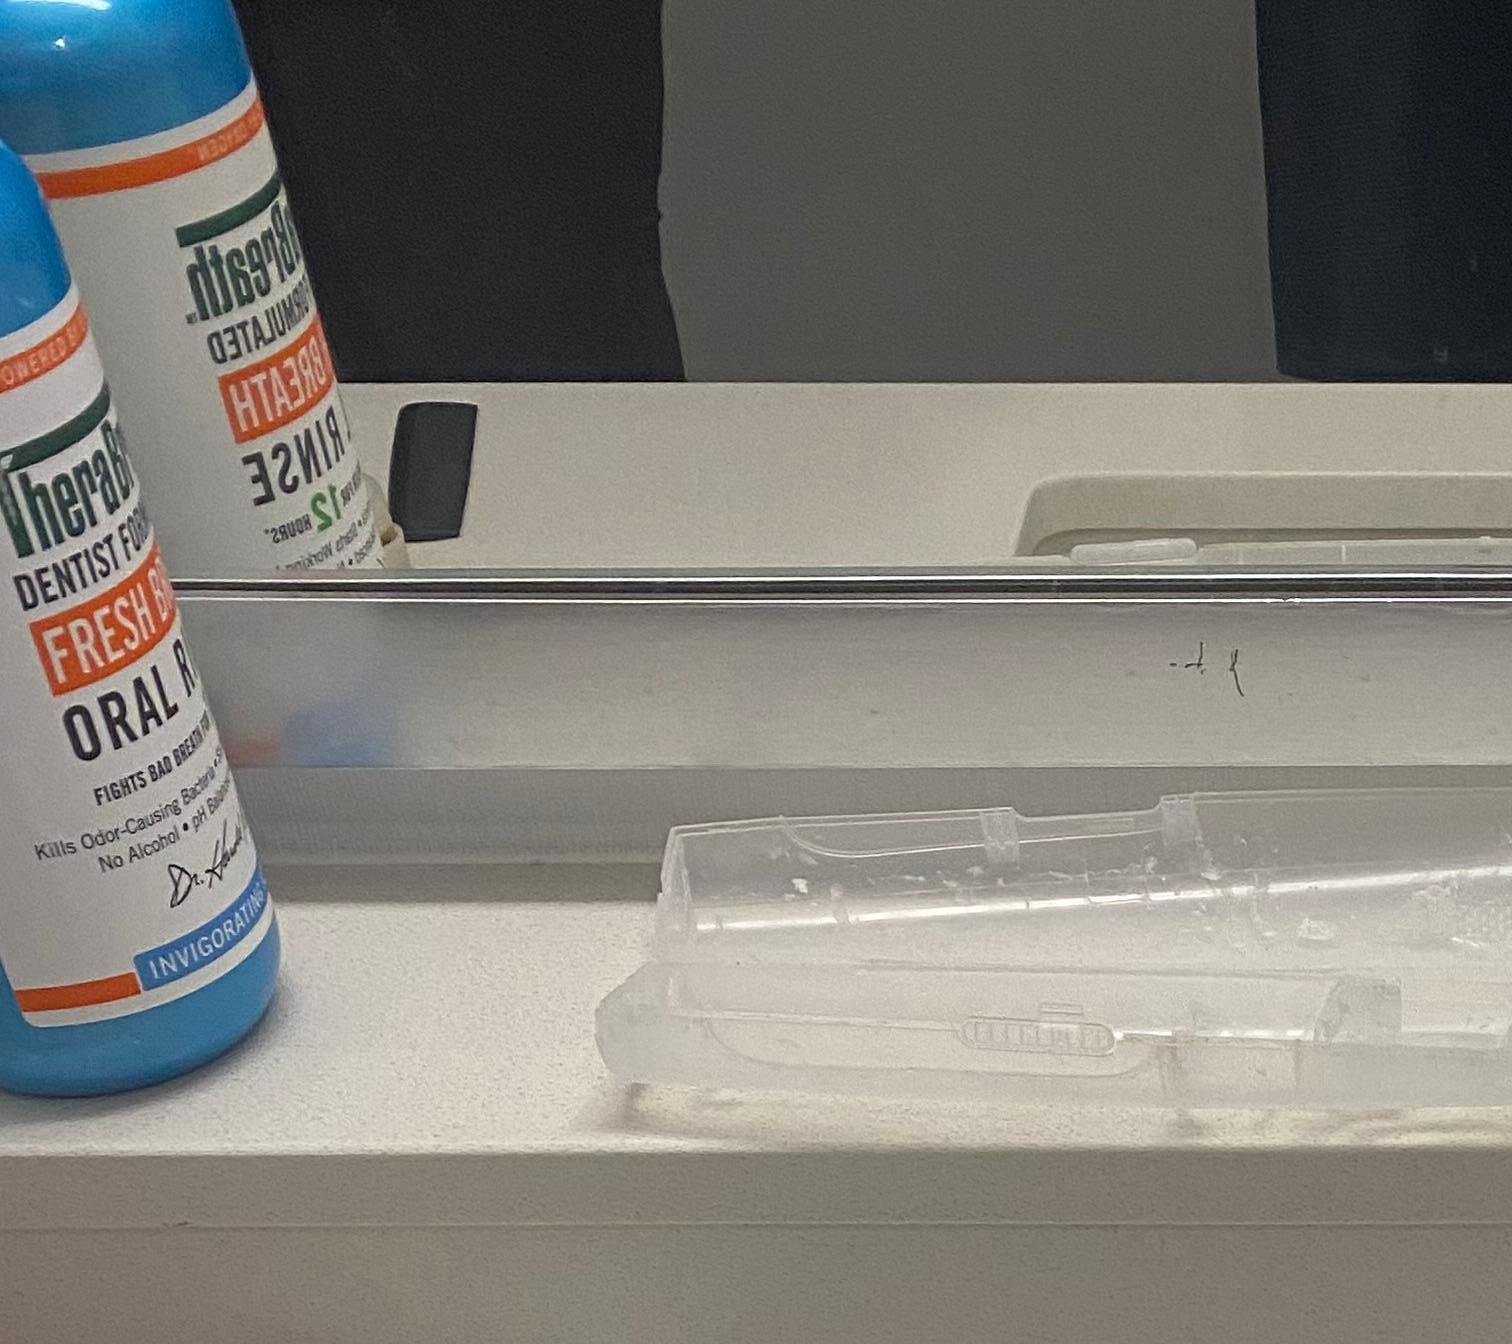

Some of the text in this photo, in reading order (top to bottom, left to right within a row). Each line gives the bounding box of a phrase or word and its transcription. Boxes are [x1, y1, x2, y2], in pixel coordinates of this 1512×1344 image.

[13, 533, 119, 611] DENTIST
[43, 583, 156, 684] FRESH
[63, 664, 179, 761] ORAL
[93, 771, 148, 806] FIGHTS
[147, 755, 173, 783] BAD
[34, 841, 77, 860] Kills
[81, 799, 182, 850] Odor-Causing
[98, 854, 124, 874] No
[129, 826, 180, 863] Alcohol
